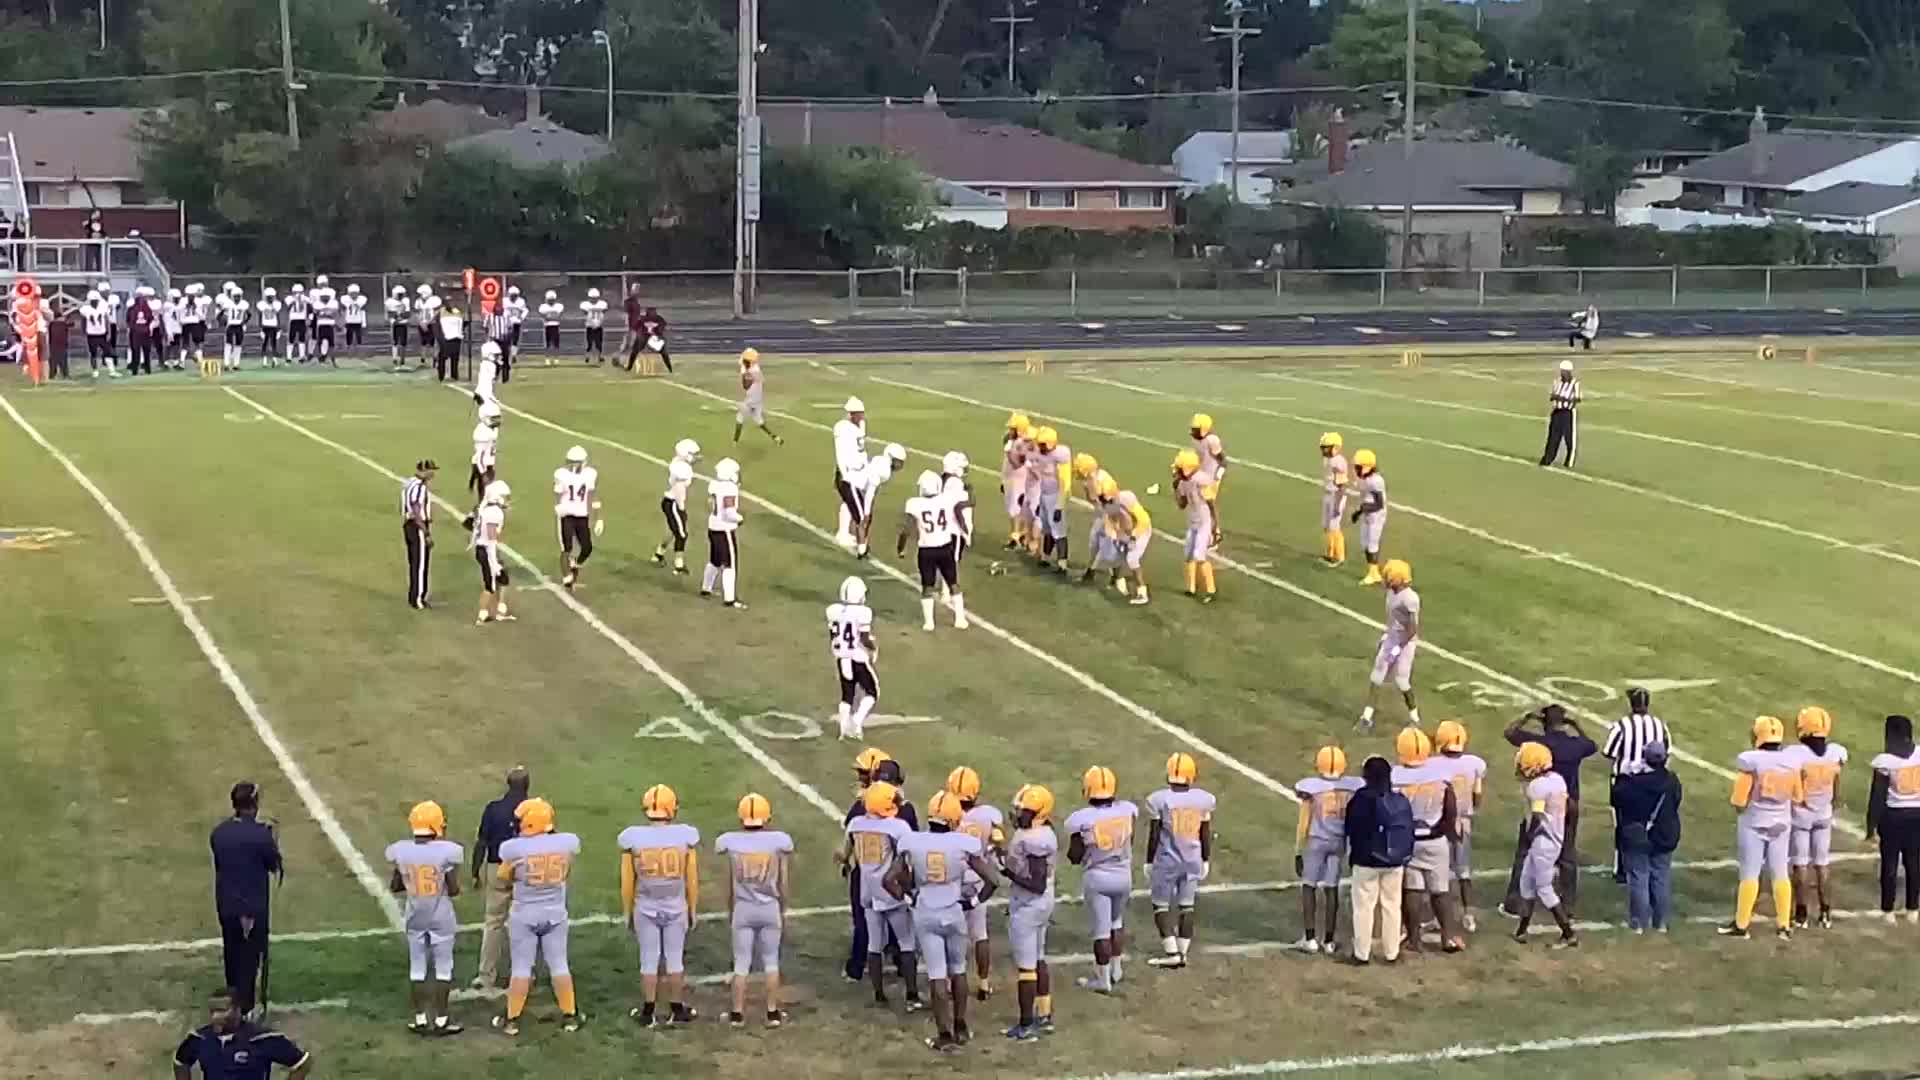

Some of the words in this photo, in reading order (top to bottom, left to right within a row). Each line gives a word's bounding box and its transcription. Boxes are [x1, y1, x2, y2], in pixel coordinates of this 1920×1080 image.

[568, 484, 587, 501] 14
[921, 509, 948, 533] 54
[831, 621, 855, 650] 24
